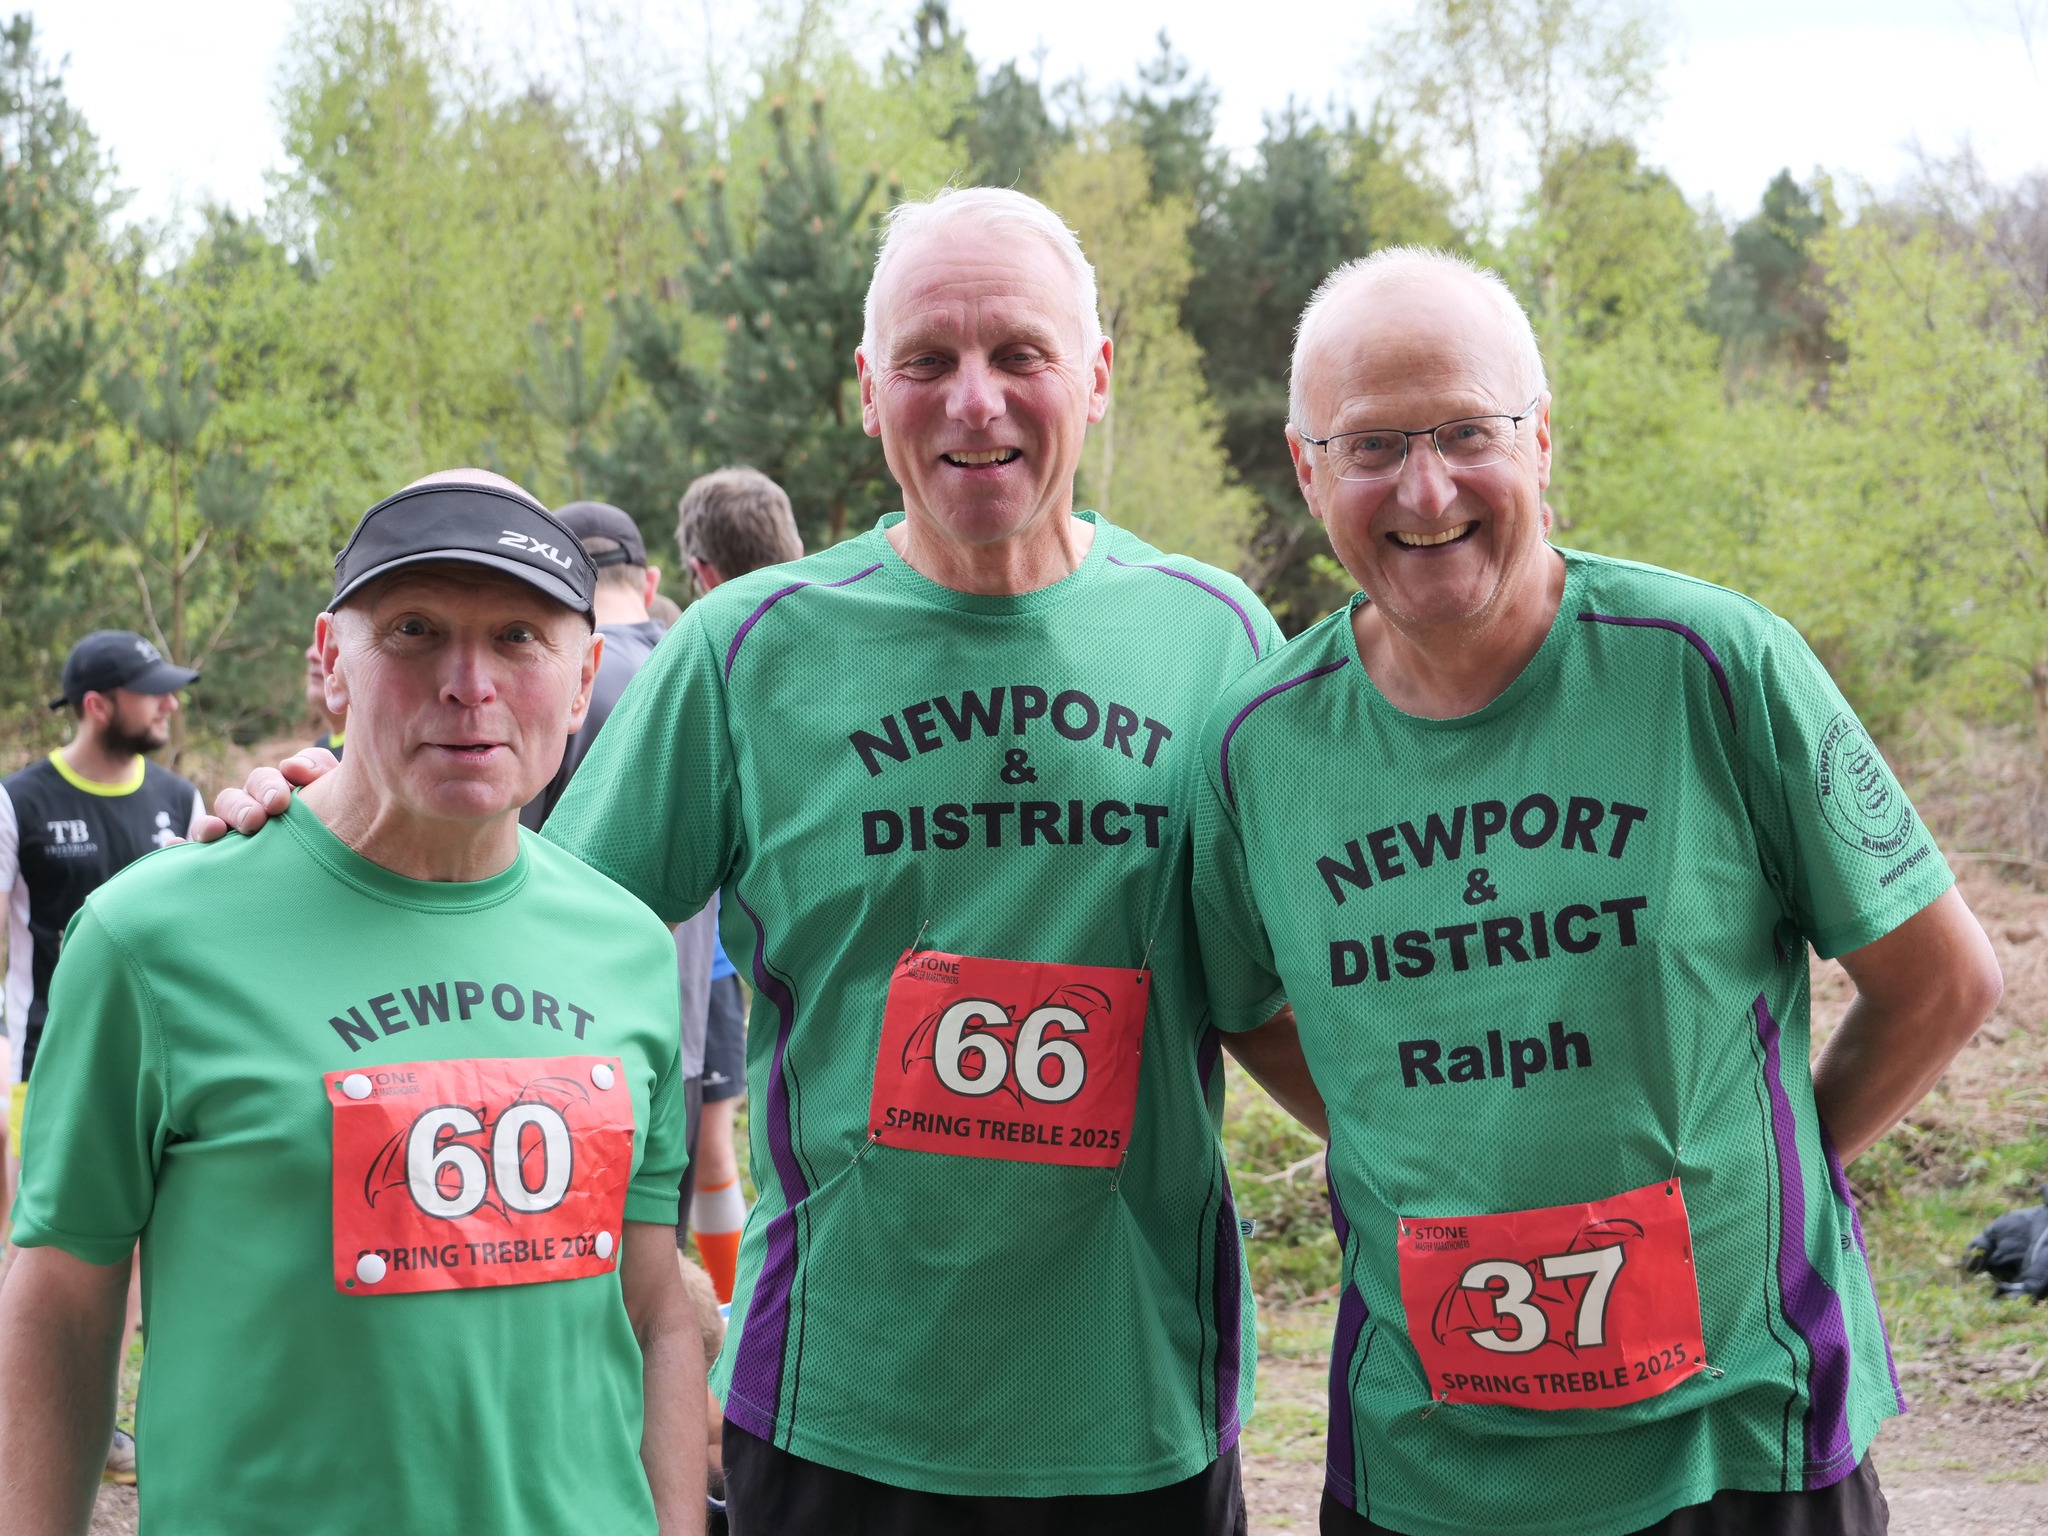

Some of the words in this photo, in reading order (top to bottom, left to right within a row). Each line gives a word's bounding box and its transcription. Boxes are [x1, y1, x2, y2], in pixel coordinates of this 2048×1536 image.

[498, 530, 573, 570] 2XU
[848, 685, 1173, 778] NEWPORT
[1000, 748, 1038, 785] &
[1820, 724, 1841, 797] NEWPORT
[47, 819, 90, 845] TB
[861, 799, 1169, 857] DISTRICT
[1315, 793, 1648, 907] NEWPORT
[1861, 834, 1902, 853] RUNNING
[1899, 805, 1911, 838] CLUB
[1462, 867, 1499, 906] &
[1880, 844, 1931, 888] SHROPSHIRE
[911, 956, 960, 975] STONE
[1329, 895, 1648, 988] DISTRICT
[328, 981, 595, 1053] NEWPORT
[931, 997, 1090, 1105] 66
[1398, 1021, 1592, 1089] Ralph
[366, 1072, 417, 1086] ONE
[884, 1107, 970, 1138] SPRING
[976, 1119, 1064, 1147] TREBLE
[1069, 1127, 1121, 1150] 2025
[404, 1100, 574, 1220] 60
[465, 1237, 555, 1267] TREBLE
[561, 1235, 598, 1259] 202
[1415, 1226, 1468, 1240] STONE
[1415, 1241, 1433, 1252] MASTER
[1457, 1241, 1627, 1355] 37
[1441, 1373, 1530, 1395] SPRING
[1533, 1366, 1630, 1395] TREBLE
[1634, 1343, 1687, 1382] 2025
